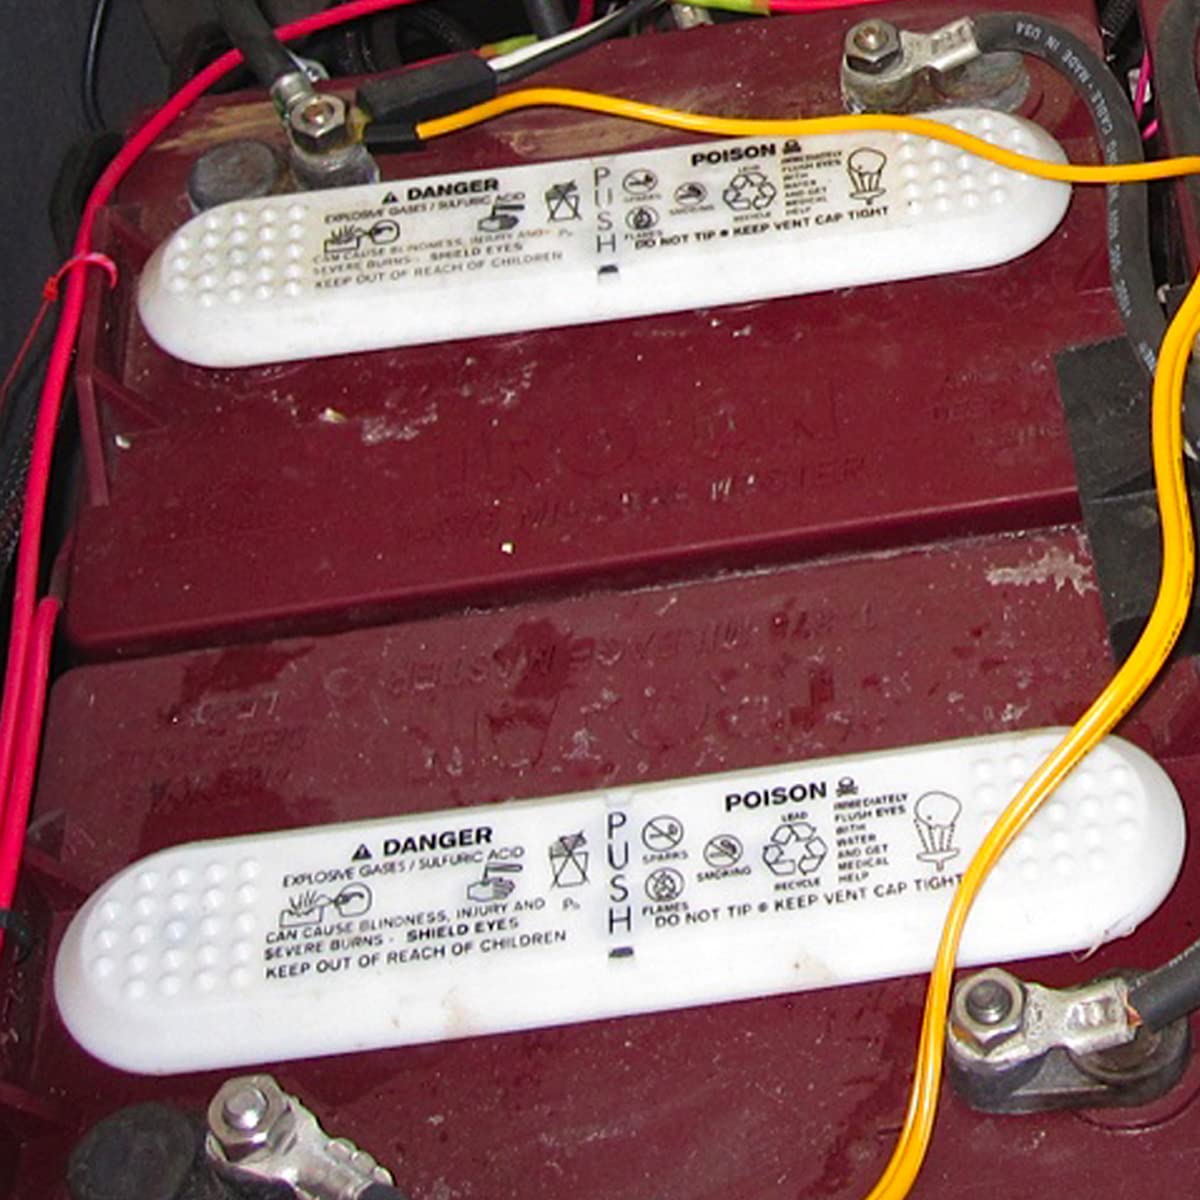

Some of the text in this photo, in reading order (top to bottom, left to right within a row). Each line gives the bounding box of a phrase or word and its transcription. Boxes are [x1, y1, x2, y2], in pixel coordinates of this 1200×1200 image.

[1045, 36, 1060, 50] IN
[692, 143, 776, 166] POISON
[407, 178, 499, 200] DANGER
[593, 167, 616, 254] PUSH
[634, 206, 889, 250] DO NOT TIP KEEP VENT CAP TIGHT
[725, 781, 827, 812] POISON
[835, 806, 906, 823] FLUSH EYES
[383, 826, 493, 857] DANGER
[282, 846, 524, 888] EXPLOSIVE GASES SULFURIC ACID
[607, 811, 631, 934] PUSH
[265, 930, 297, 944] CAN
[303, 923, 353, 940] CAUSE
[456, 901, 508, 920] INJURY
[513, 898, 546, 911] AND
[655, 873, 963, 929] DO NOT TIP KEEP VENT CAP TIGHT
[264, 917, 520, 961] SEVERE BURNS SHIELD EYES
[266, 930, 567, 980] KEEP OUT OF REACH OF CHILDREN
